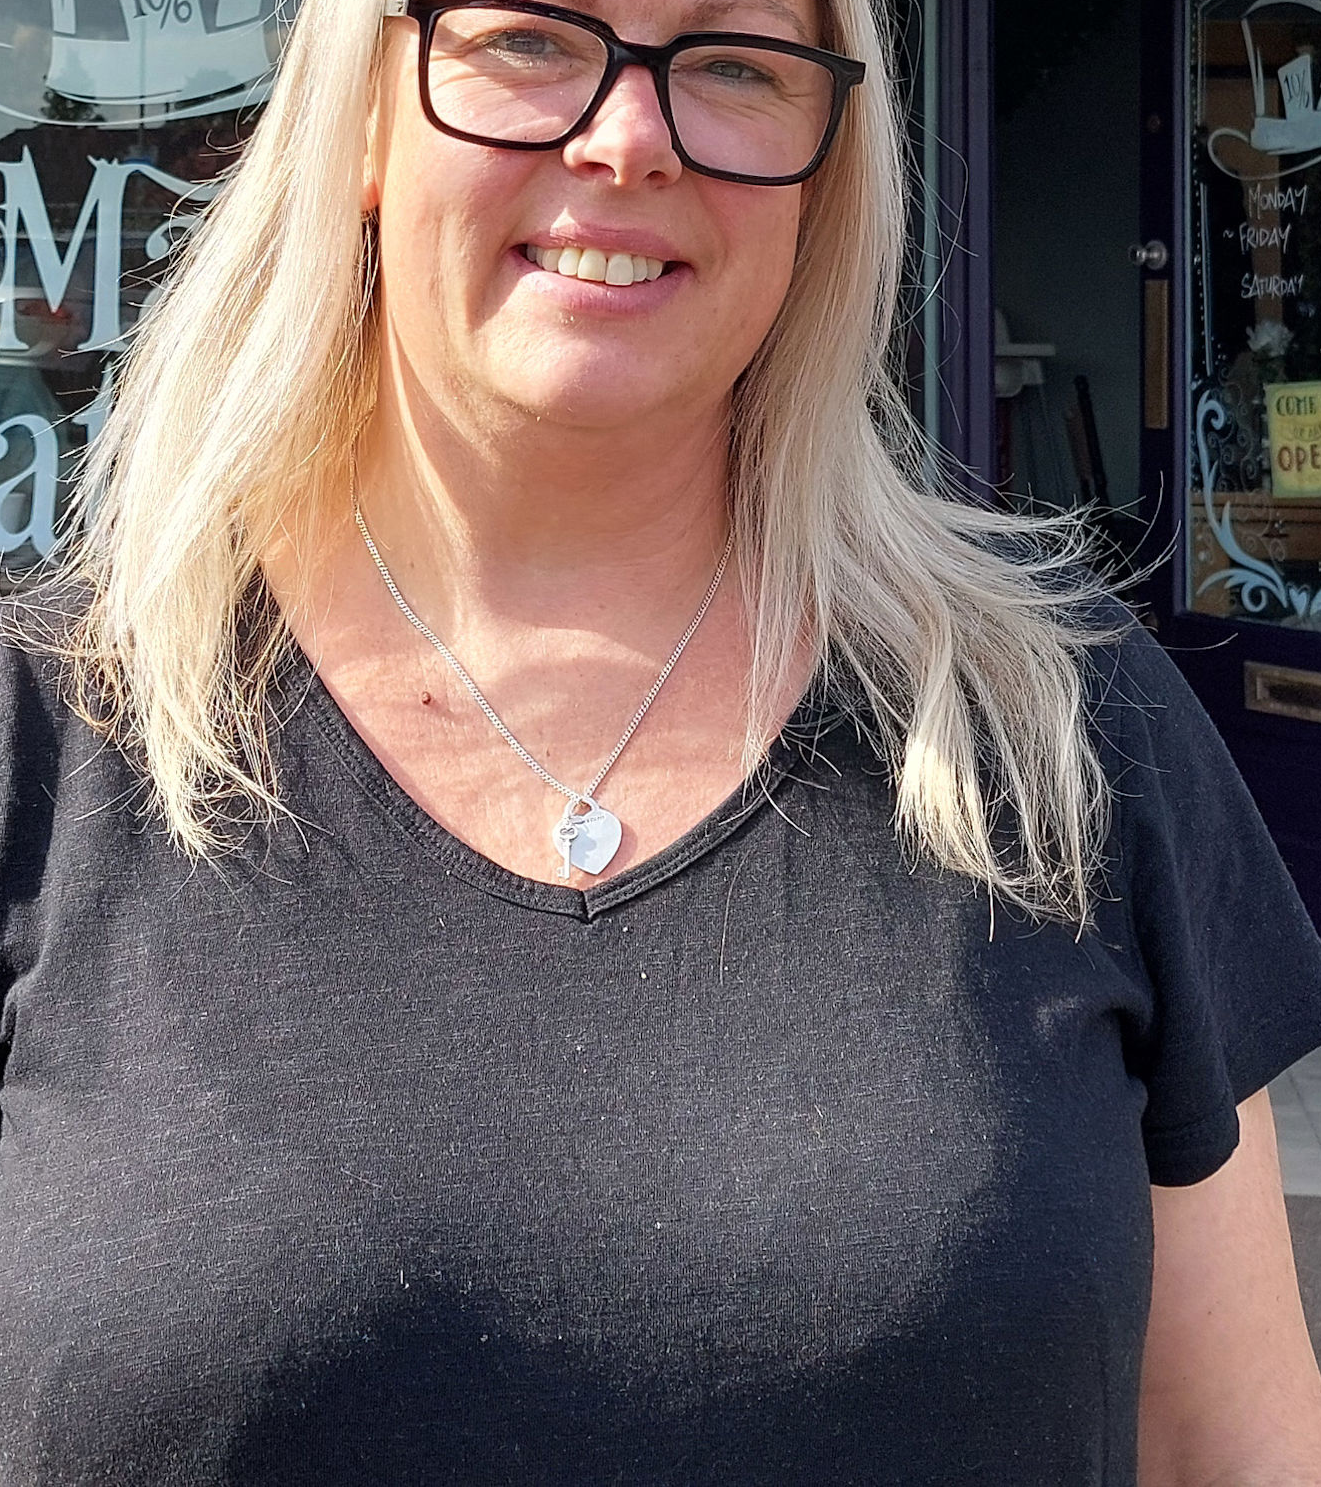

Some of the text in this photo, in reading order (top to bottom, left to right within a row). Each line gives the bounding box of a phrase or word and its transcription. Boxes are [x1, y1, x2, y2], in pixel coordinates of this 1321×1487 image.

[1247, 183, 1308, 220] MONDAY
[1239, 222, 1292, 256] FRIDAY
[1240, 272, 1304, 299] SATURDAY
[1276, 395, 1317, 417] COME
